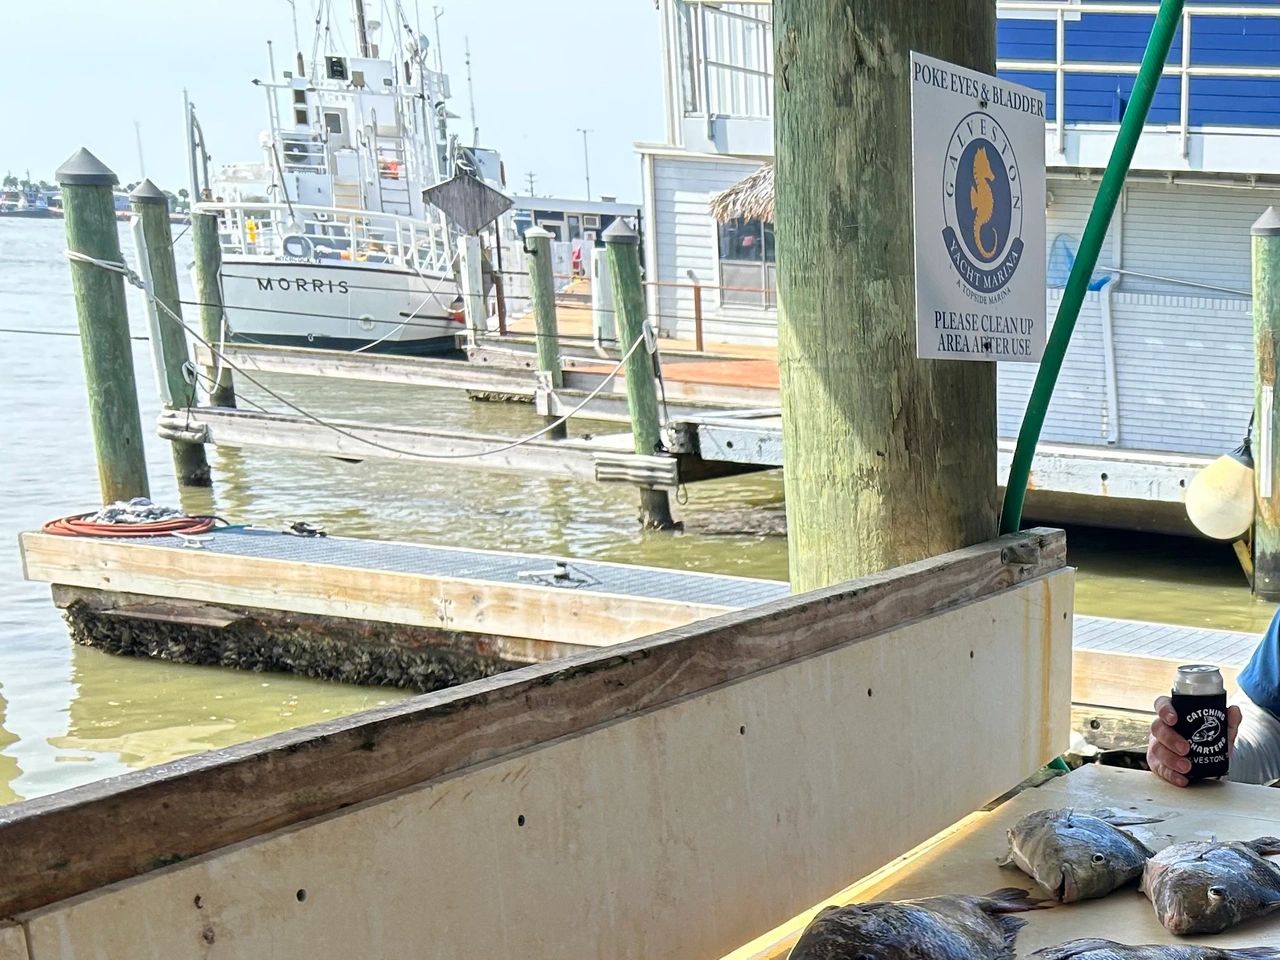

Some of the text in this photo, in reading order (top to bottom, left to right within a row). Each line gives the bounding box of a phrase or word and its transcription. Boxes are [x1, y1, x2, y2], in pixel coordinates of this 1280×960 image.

[914, 61, 1044, 117] POKE EYES & BLADDER
[946, 118, 1021, 209] GALVESTON
[950, 239, 1018, 289] YACHT MARINA
[256, 277, 349, 294] MORRIS
[962, 285, 988, 305] TOPSIDE
[988, 287, 1011, 305] MARINA
[934, 310, 1034, 335] PLEASE CLEAN UP
[937, 333, 1032, 356] AREA AFTER USE
[1186, 708, 1226, 723] CATCHING
